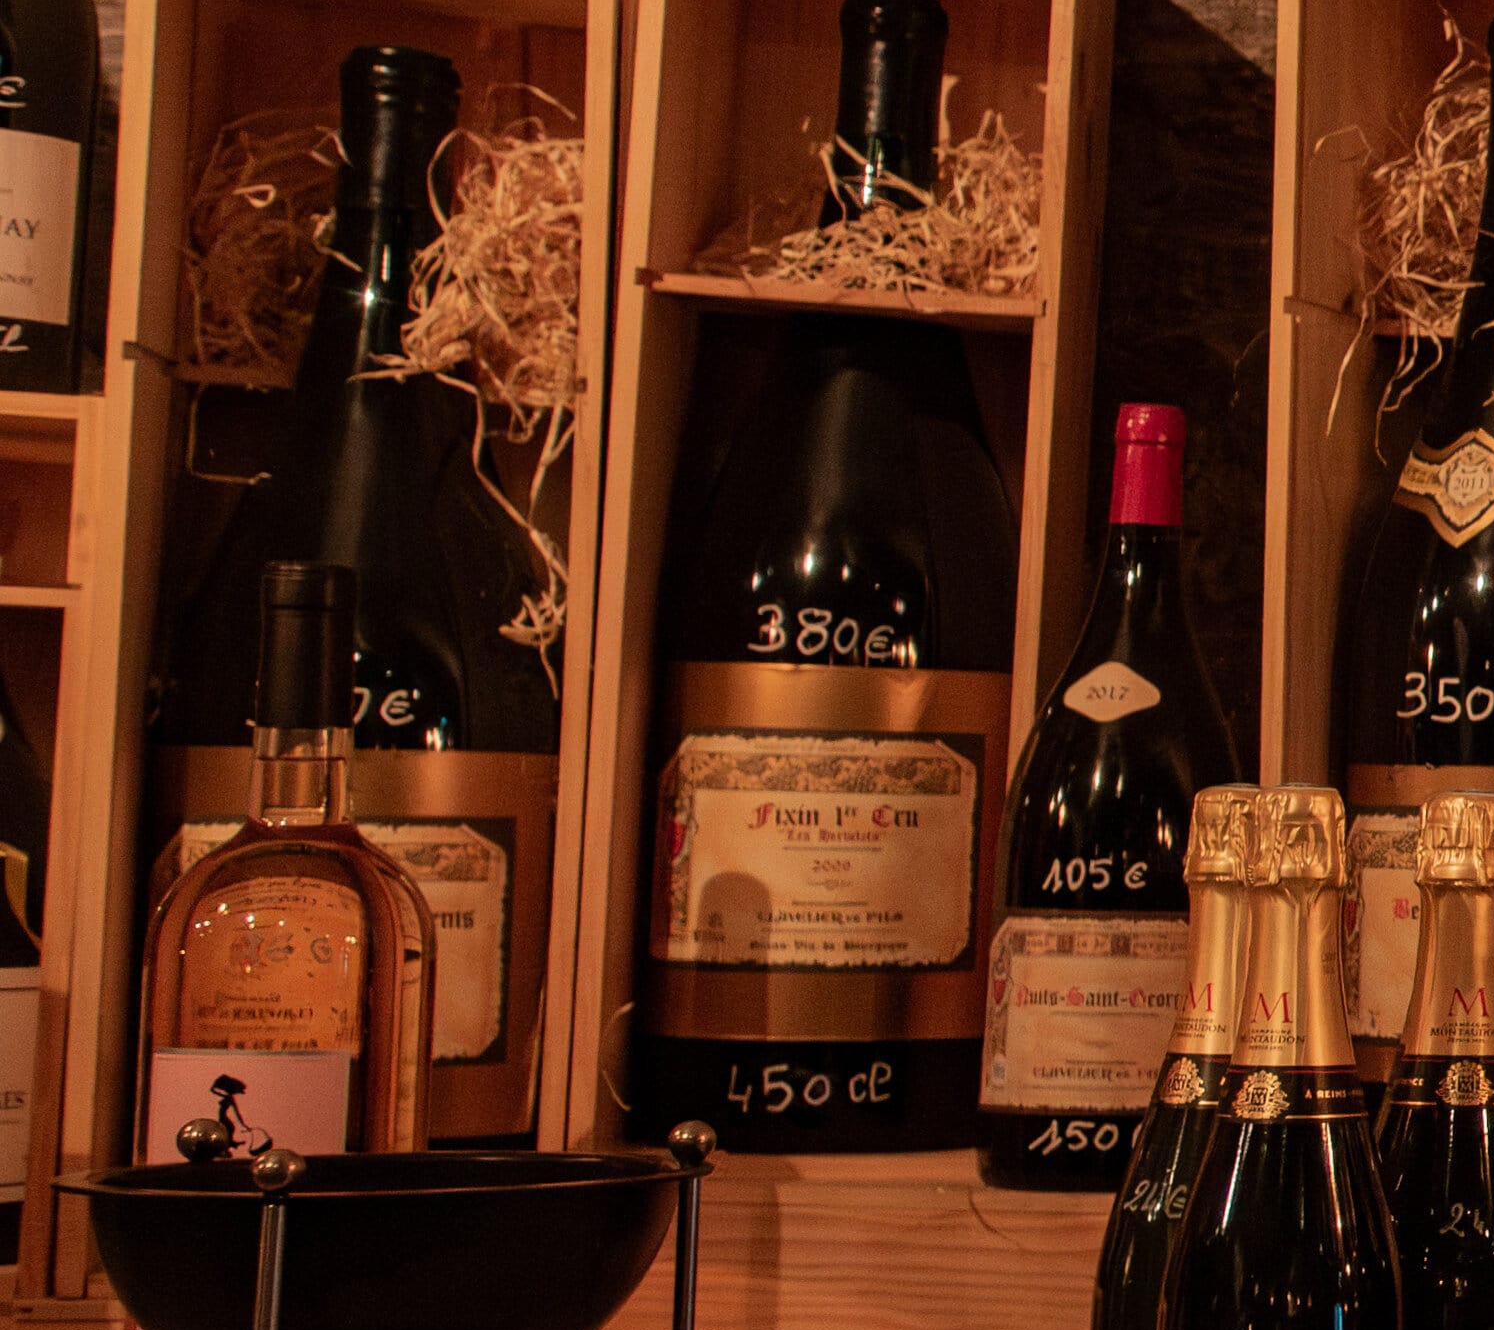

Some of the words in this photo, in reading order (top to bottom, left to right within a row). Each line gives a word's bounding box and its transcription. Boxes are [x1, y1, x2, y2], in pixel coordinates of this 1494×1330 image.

[747, 603, 896, 661] 380€
[747, 802, 820, 829] Fixin
[871, 804, 920, 829] Cru
[1040, 856, 1113, 894] 105
[1123, 861, 1149, 891] €
[1250, 991, 1294, 1024] M
[1448, 985, 1489, 1018] M
[726, 1064, 832, 1114] 450
[1028, 1119, 1120, 1157] 150
